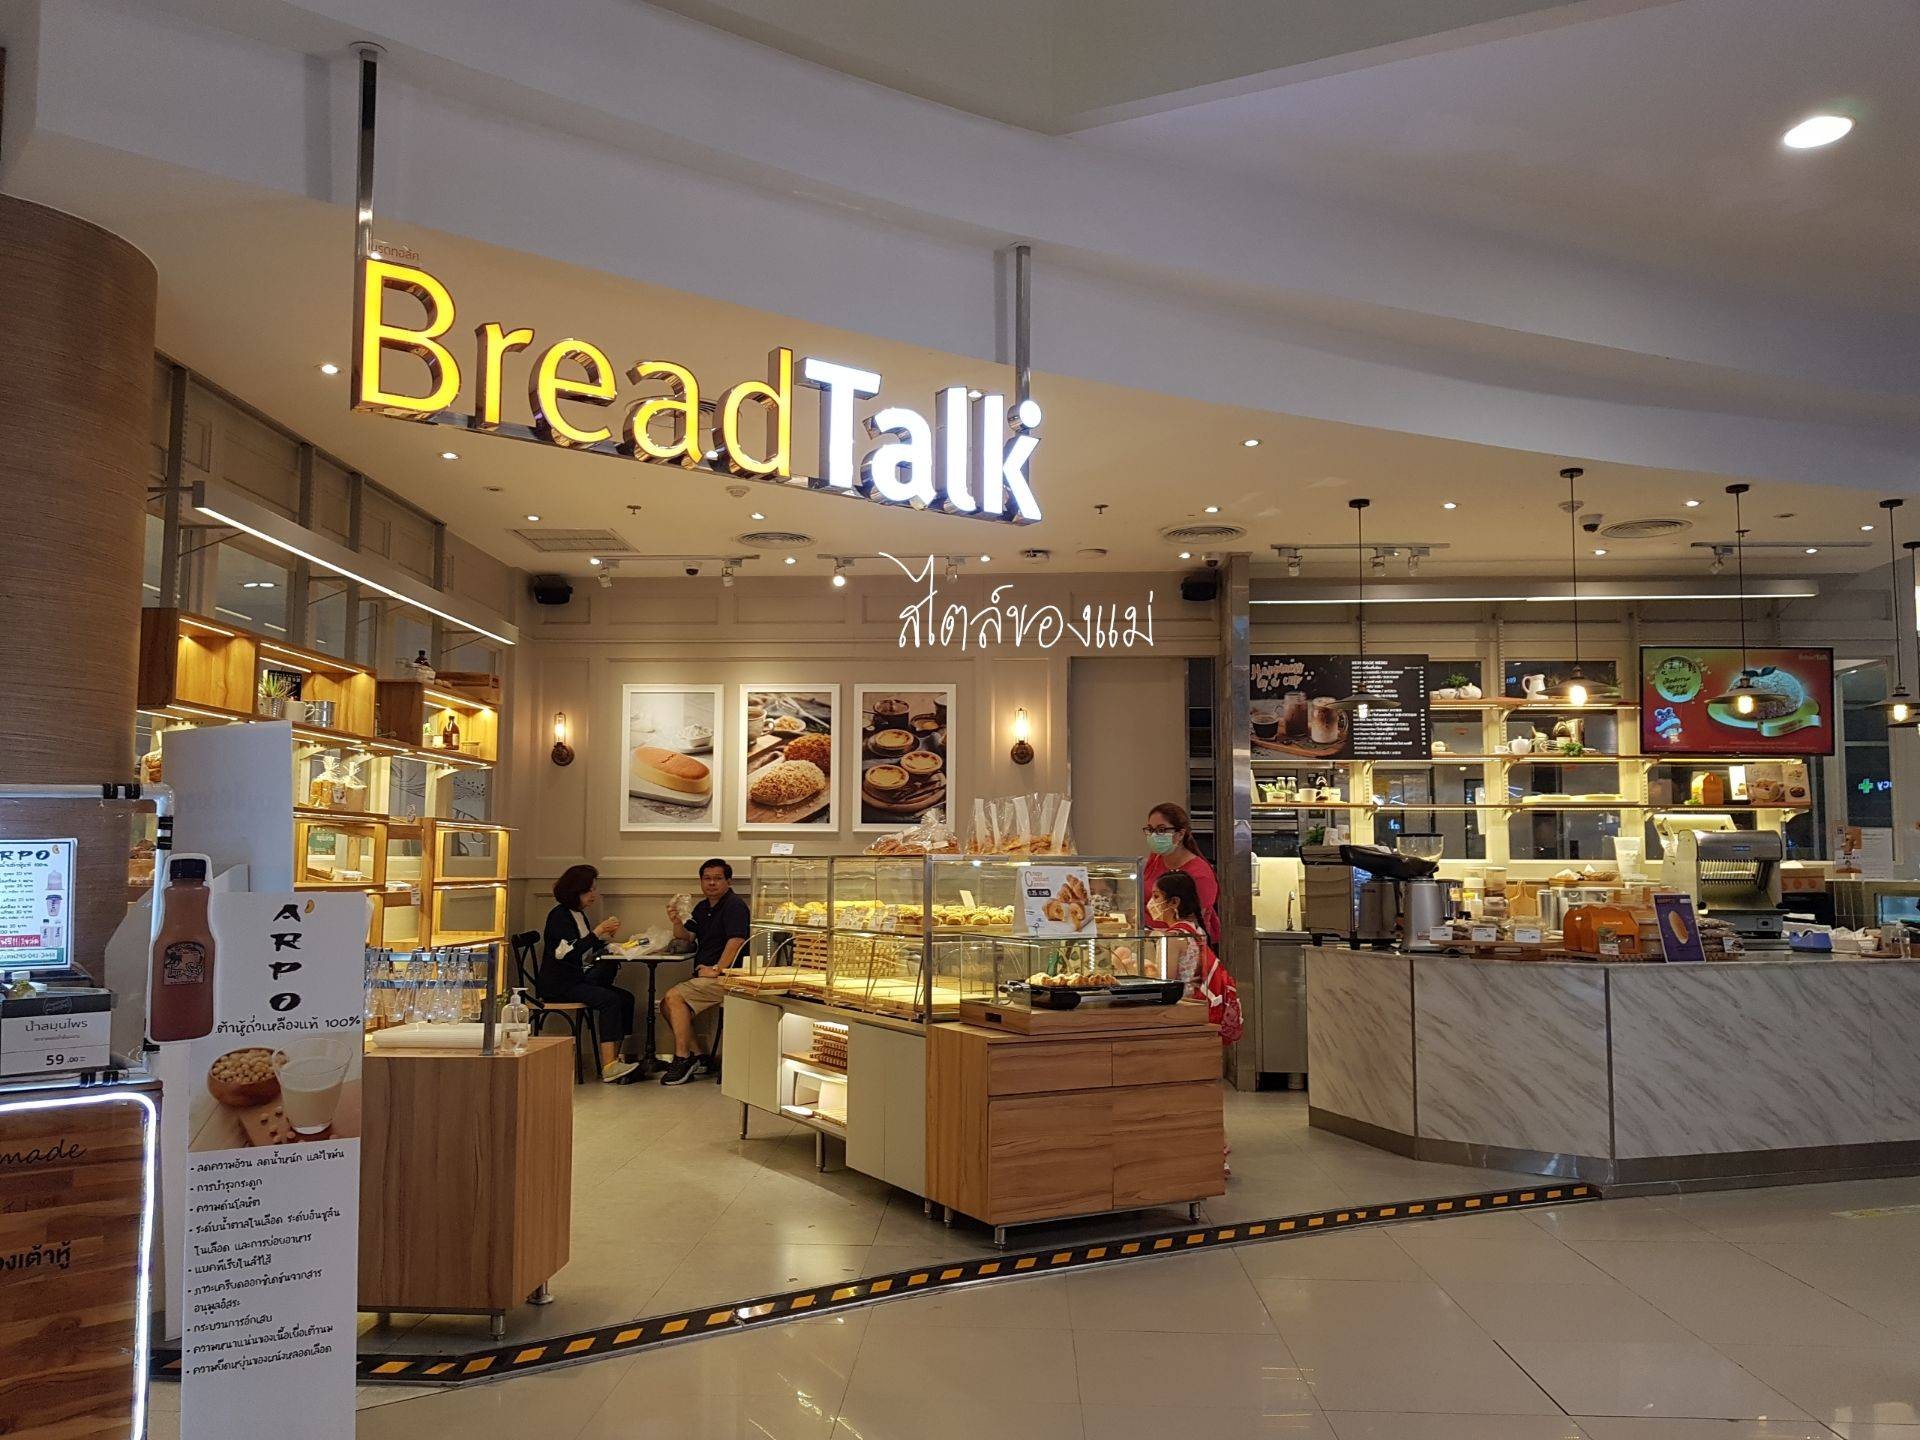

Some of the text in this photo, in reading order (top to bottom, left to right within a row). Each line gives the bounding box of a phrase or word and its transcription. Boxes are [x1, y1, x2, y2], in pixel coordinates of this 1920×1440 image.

[353, 258, 1043, 523] BreadTalk
[215, 1015, 361, 1037] ต้าหู้ถั่วเหลืองแท้ 100%
